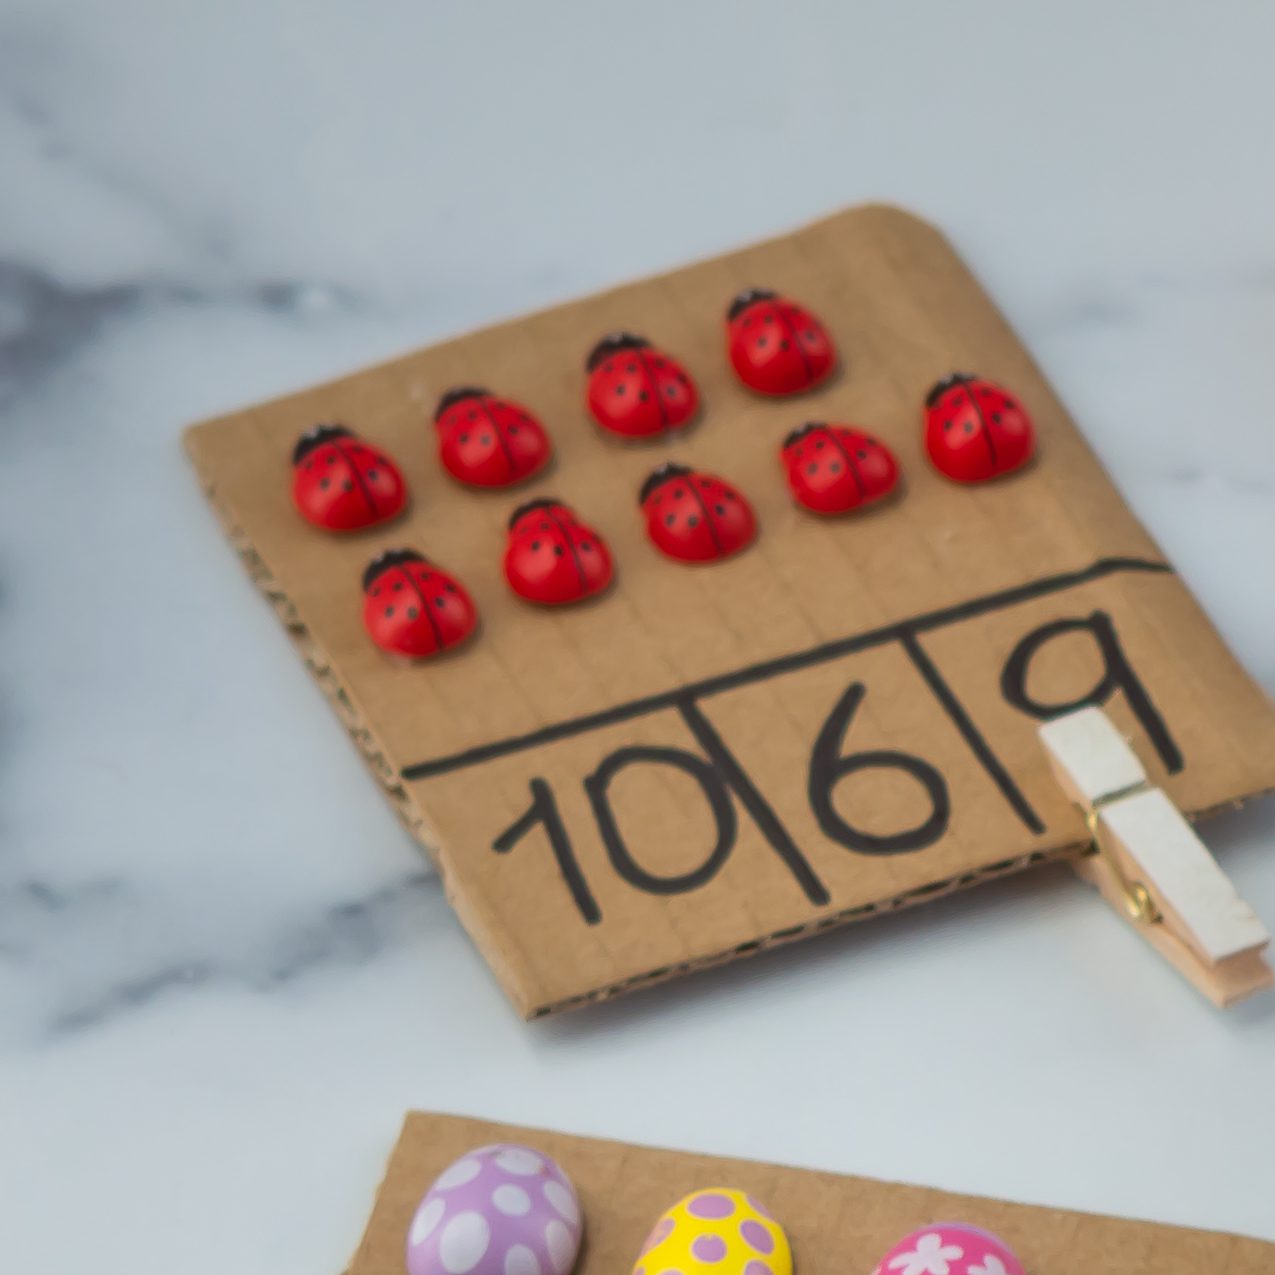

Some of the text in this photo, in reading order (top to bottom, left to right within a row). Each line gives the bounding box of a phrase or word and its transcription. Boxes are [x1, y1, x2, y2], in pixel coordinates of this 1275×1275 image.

[492, 610, 1183, 925] 10 6 9
